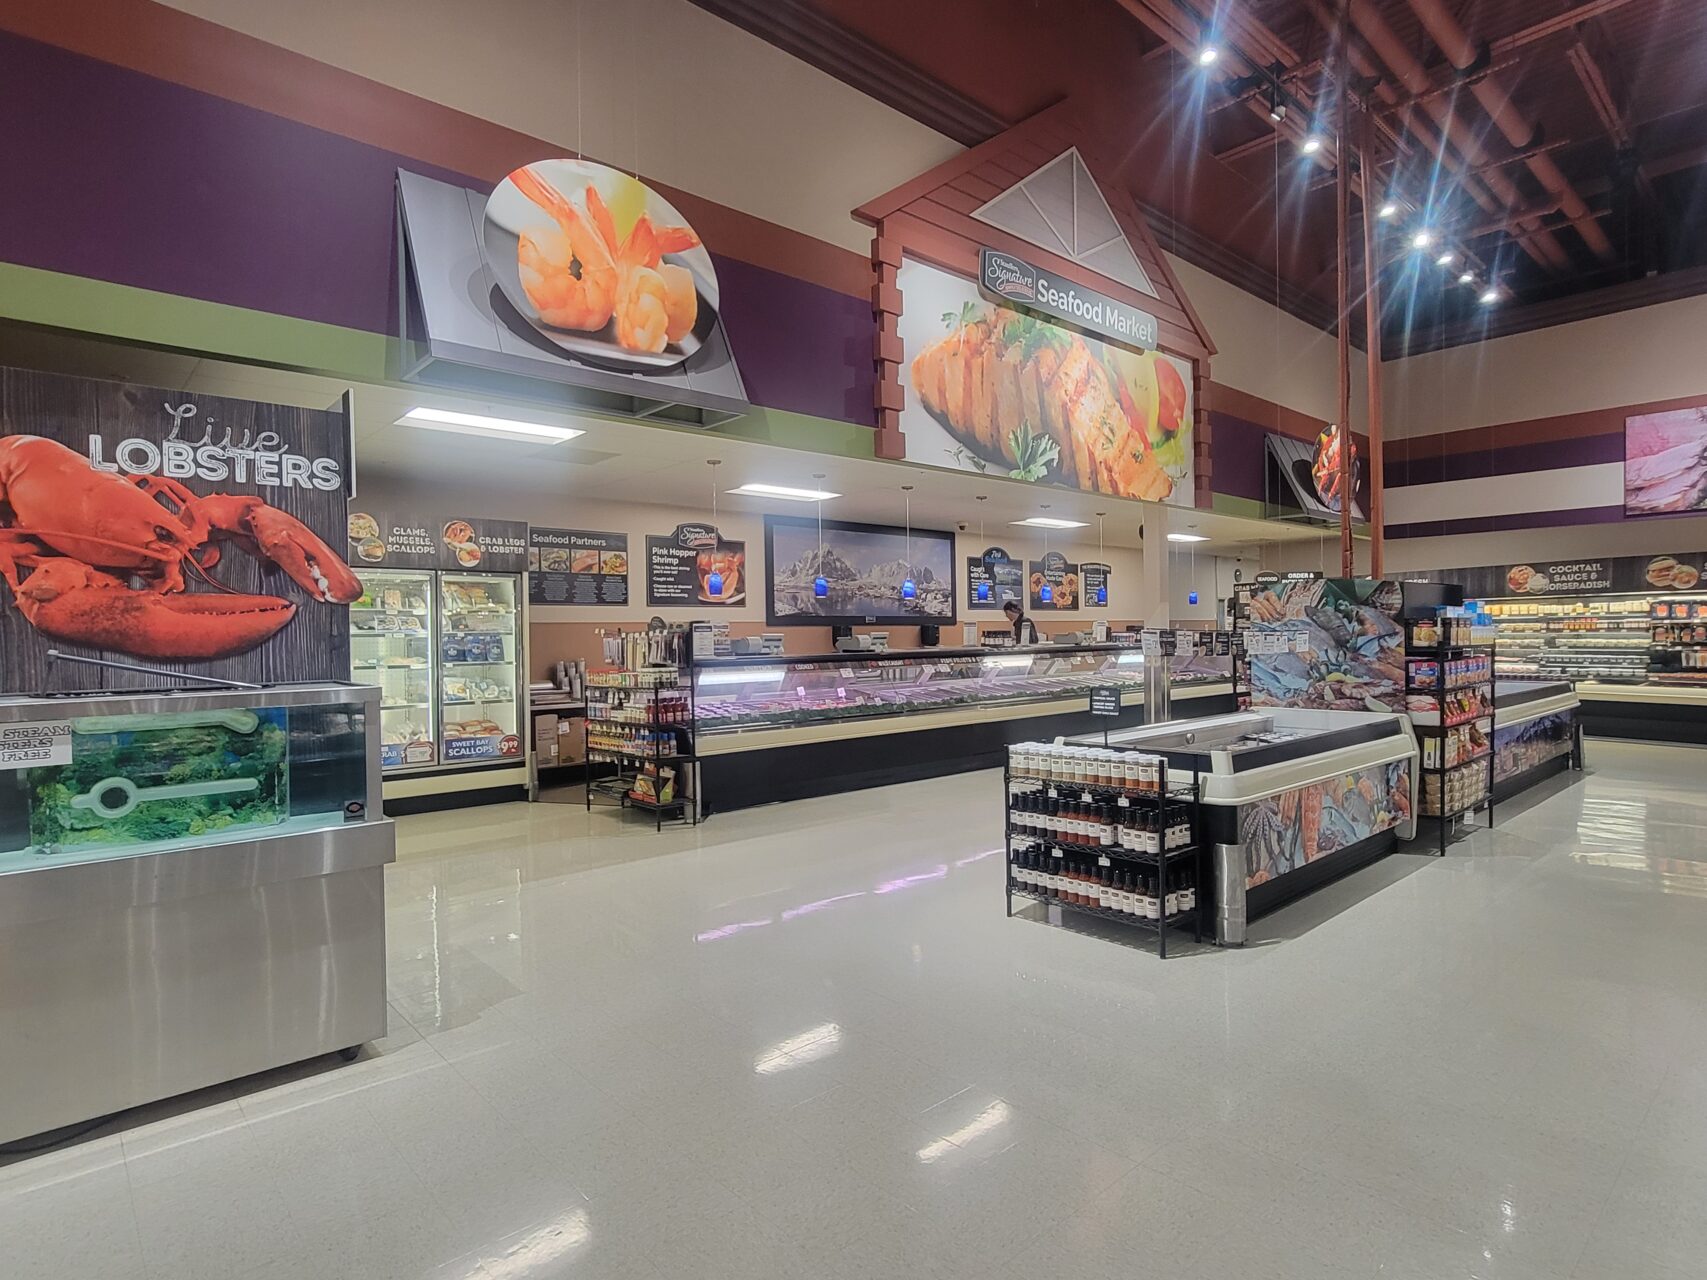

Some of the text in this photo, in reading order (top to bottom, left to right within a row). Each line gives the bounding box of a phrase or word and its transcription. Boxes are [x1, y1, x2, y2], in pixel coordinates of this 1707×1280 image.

[988, 257, 1033, 290] Signature
[1038, 279, 1152, 342] Seafood Market
[164, 402, 288, 454] Live
[89, 434, 340, 491] LOBSTERS
[478, 536, 526, 546] CRAB LEGS
[532, 534, 606, 546] Seafood Partners
[386, 544, 436, 554] SCALLOPS
[488, 545, 525, 554] LOBSTER
[652, 547, 696, 558] Pink Hopper
[652, 556, 679, 565] Shrimp
[1549, 563, 1603, 574] COCKTAIL
[1554, 573, 1588, 582] SAUCE
[3, 725, 71, 739] STEAM
[2, 749, 51, 762] FREE
[448, 746, 493, 757] SCALLOPS
